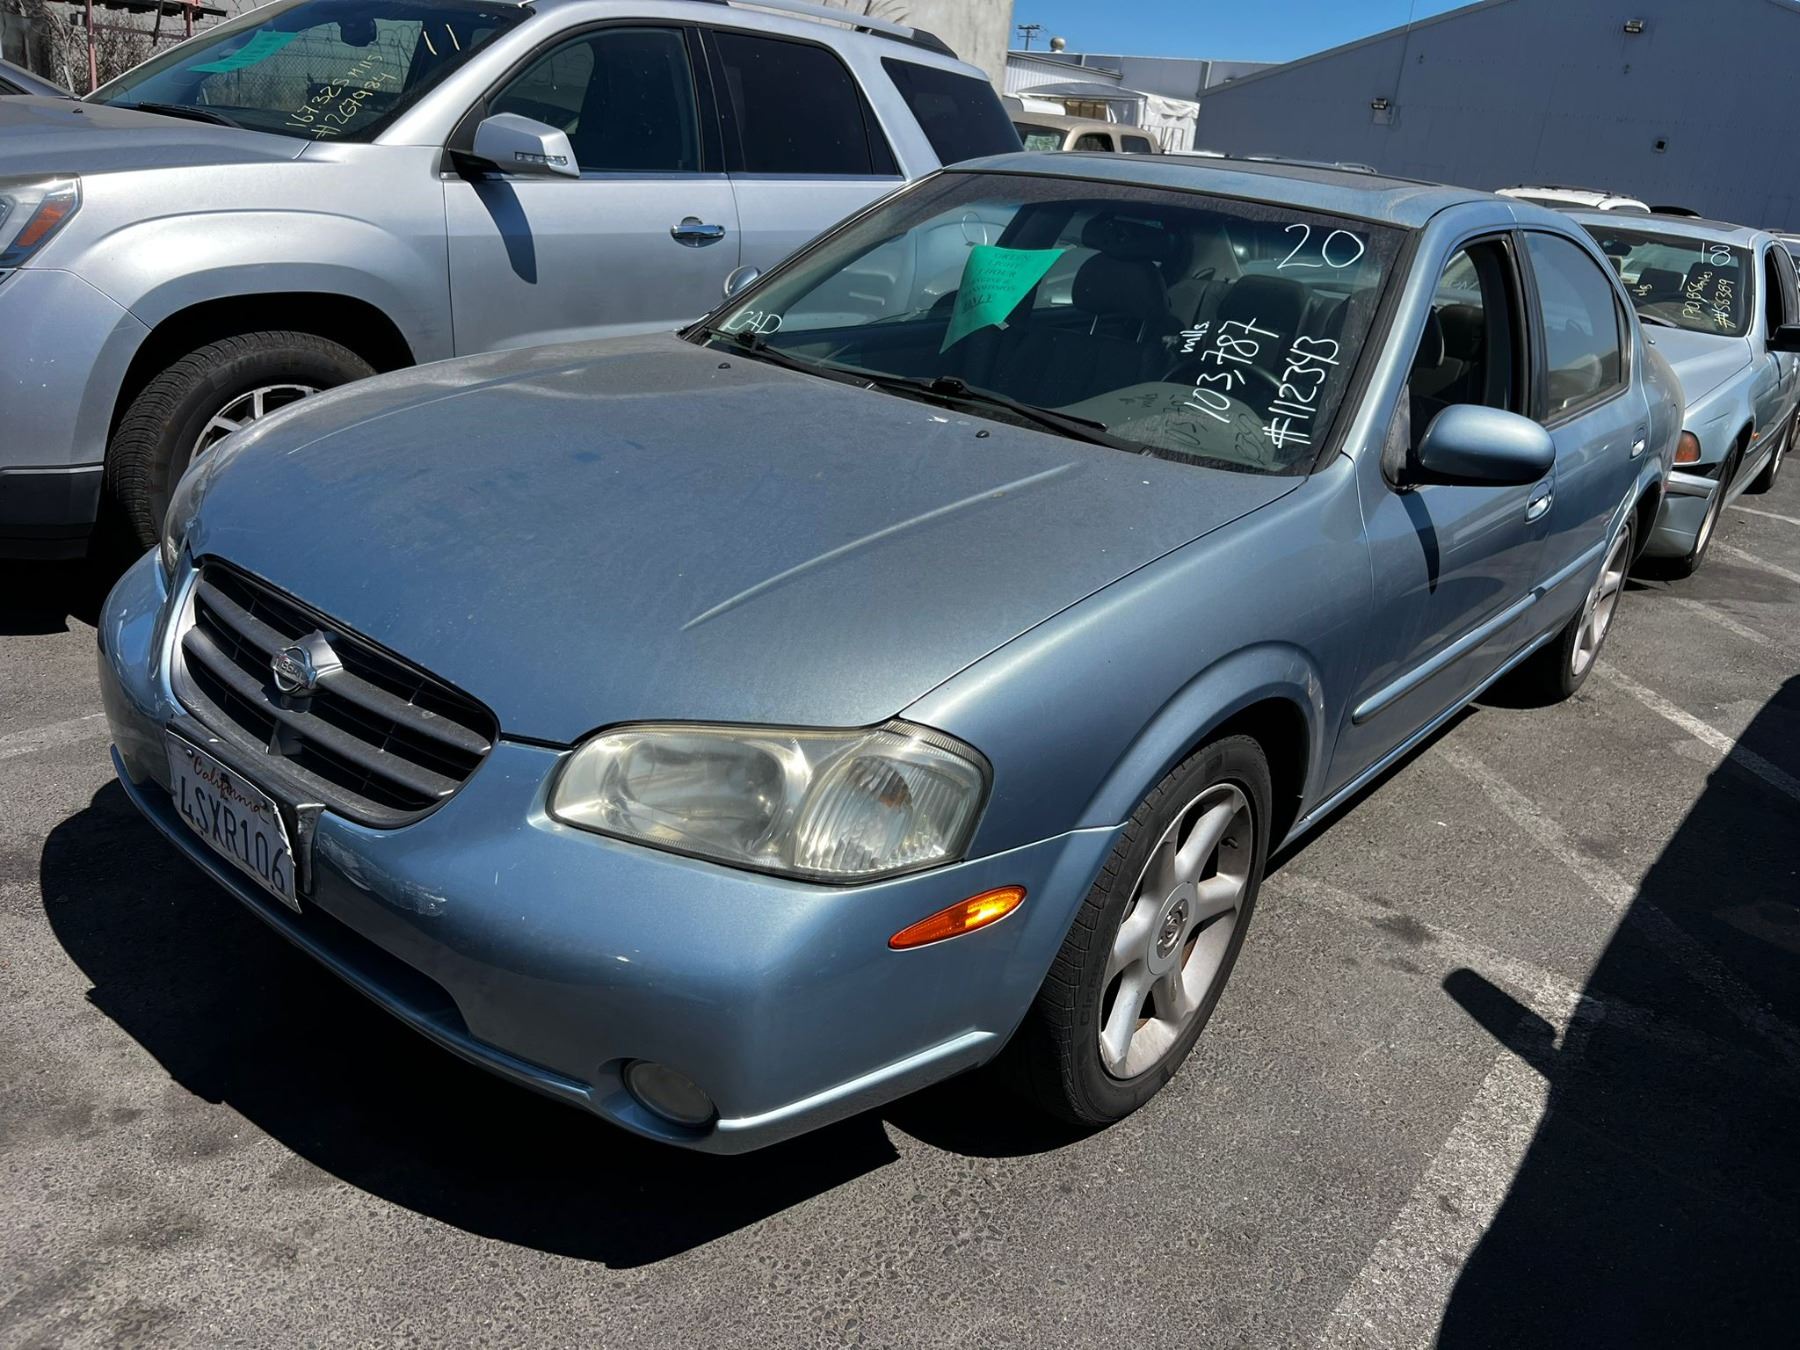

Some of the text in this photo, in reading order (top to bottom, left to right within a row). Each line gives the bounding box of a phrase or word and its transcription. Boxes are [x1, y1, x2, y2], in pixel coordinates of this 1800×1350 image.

[1276, 223, 1365, 270] 20
[1701, 241, 1731, 267] 18
[181, 775, 285, 892] 4SXR106
